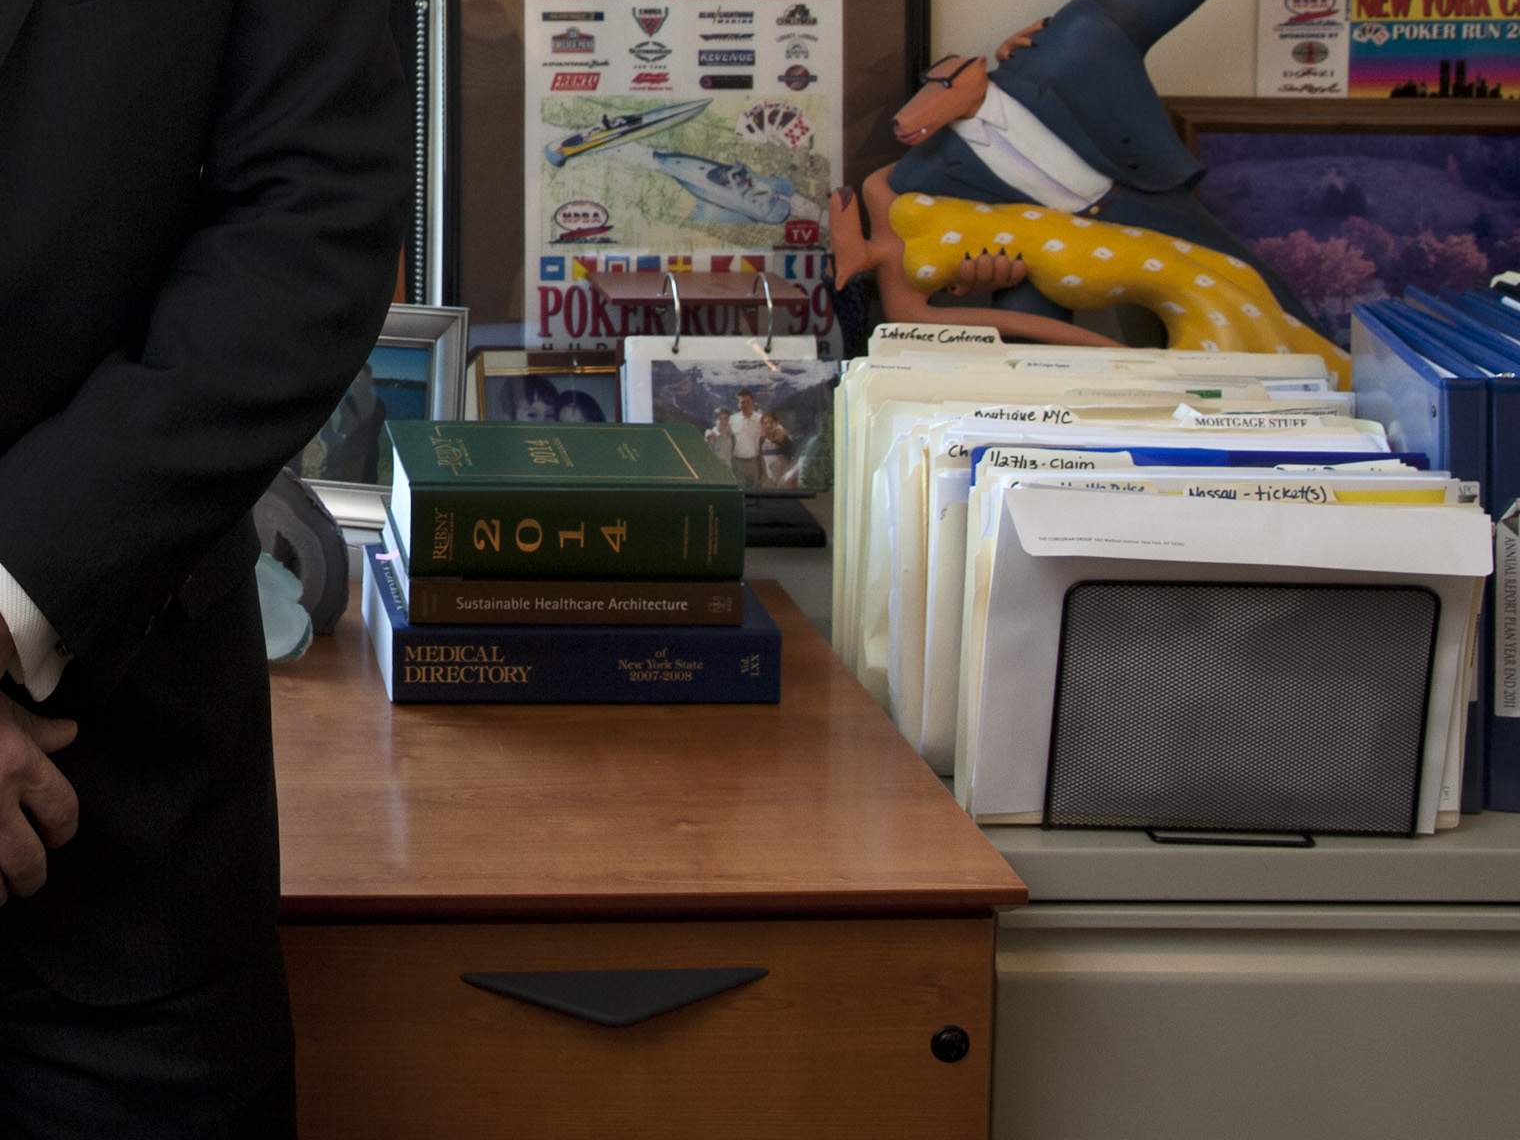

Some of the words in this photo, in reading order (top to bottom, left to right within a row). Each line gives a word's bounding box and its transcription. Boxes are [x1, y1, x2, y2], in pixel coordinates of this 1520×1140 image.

[1391, 22, 1457, 40] POKER
[1461, 22, 1502, 39] RUN
[699, 52, 754, 62] REVENGE
[791, 229, 813, 241] TV
[538, 285, 667, 338] POKER
[880, 327, 935, 344] Interface
[937, 328, 996, 345] Conference
[1042, 410, 1073, 425] NYC
[1194, 417, 1266, 429] MORTGAGE
[1268, 417, 1309, 429] STUFF
[524, 439, 560, 465] 2014
[947, 444, 969, 458] Ch
[1049, 456, 1096, 470] Claim
[431, 509, 450, 560] REBNY
[1503, 537, 1517, 577] ANNUAL
[455, 596, 531, 611] Sustainable
[535, 596, 605, 611] Healthcare
[608, 596, 689, 612] Architecture
[1503, 578, 1517, 616] REPORT
[1503, 617, 1517, 641] PLAN
[404, 645, 505, 663] MEDICAL
[654, 647, 668, 658] of
[1503, 642, 1517, 665] YEAR
[617, 659, 643, 671] New
[644, 659, 674, 671] York
[675, 659, 704, 671] State
[404, 665, 533, 684] DIRECTORY
[628, 670, 693, 682] 2007-2008
[1503, 667, 1517, 688] END
[1503, 689, 1517, 709] 2011
